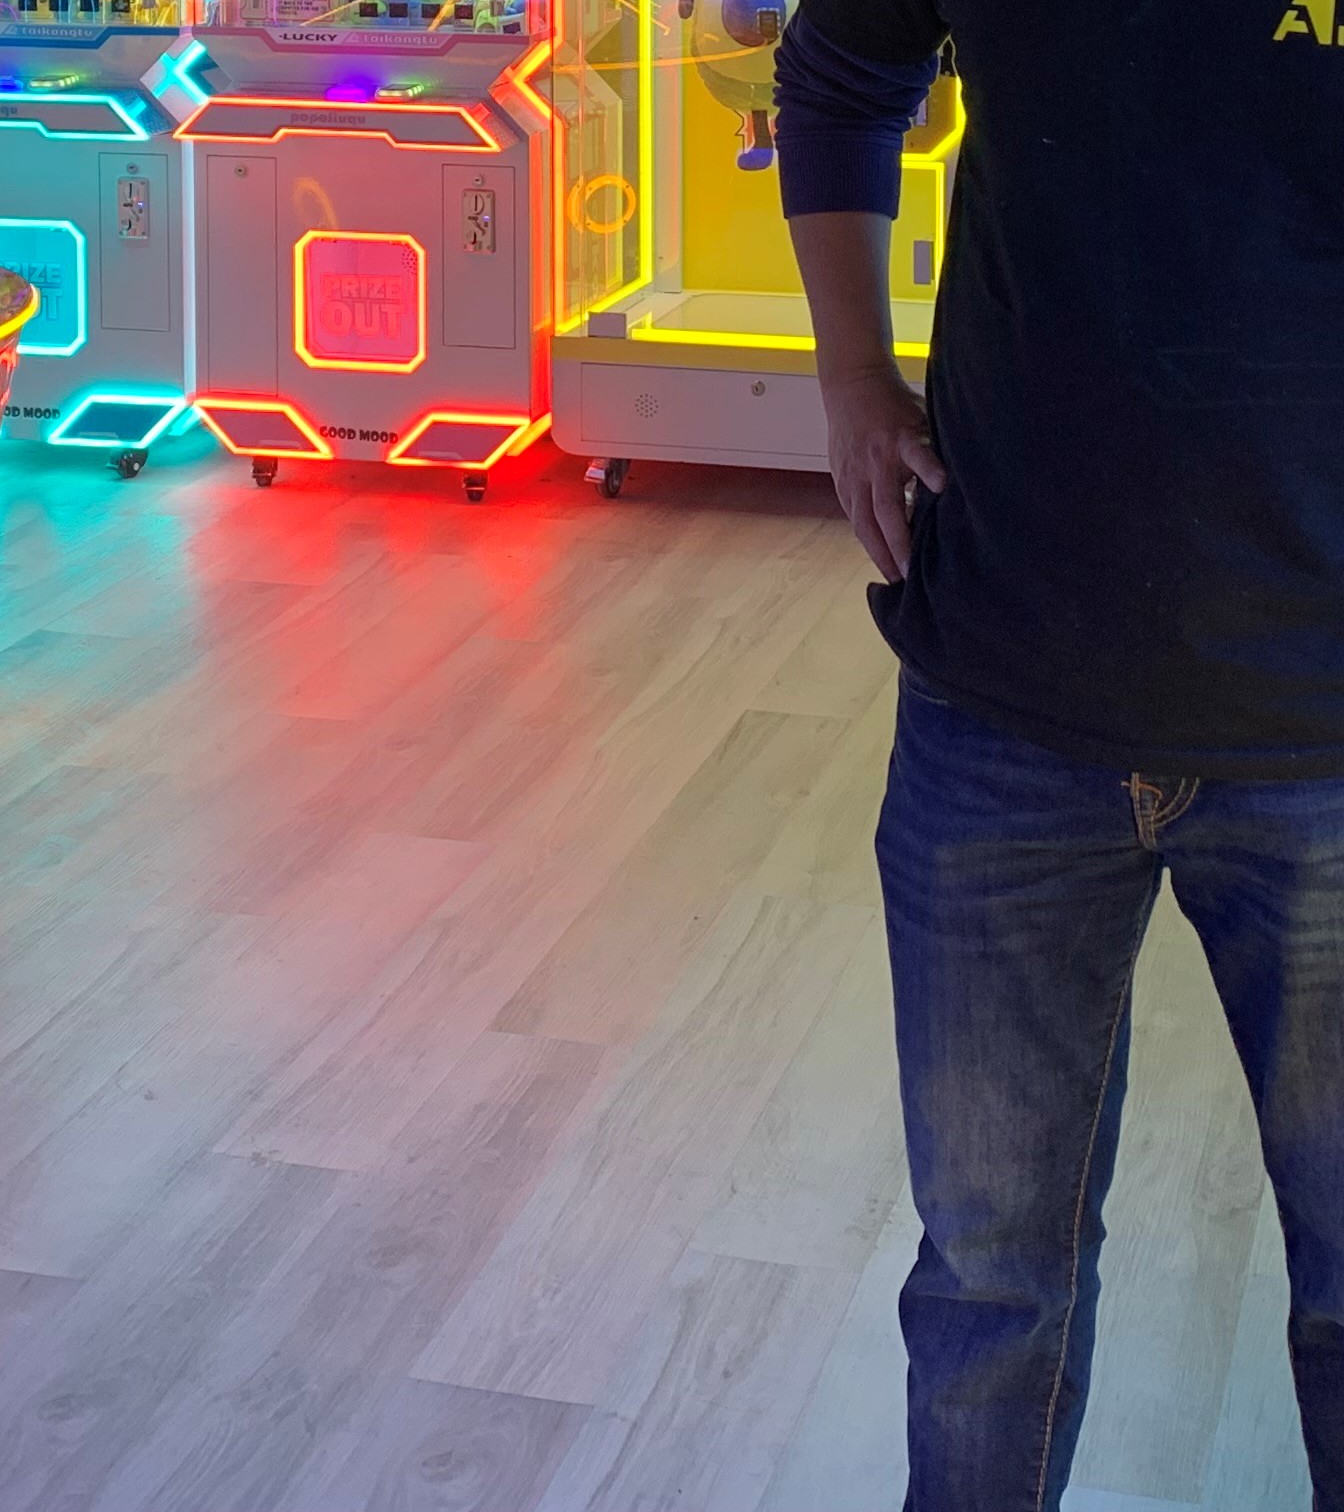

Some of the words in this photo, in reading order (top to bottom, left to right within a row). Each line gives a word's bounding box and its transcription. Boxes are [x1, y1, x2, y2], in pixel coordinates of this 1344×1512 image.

[321, 273, 404, 300] PRIZE
[321, 301, 405, 338] OUT
[23, 407, 60, 420] MOOD
[319, 426, 356, 440] GOOD
[359, 429, 399, 444] MOOD
